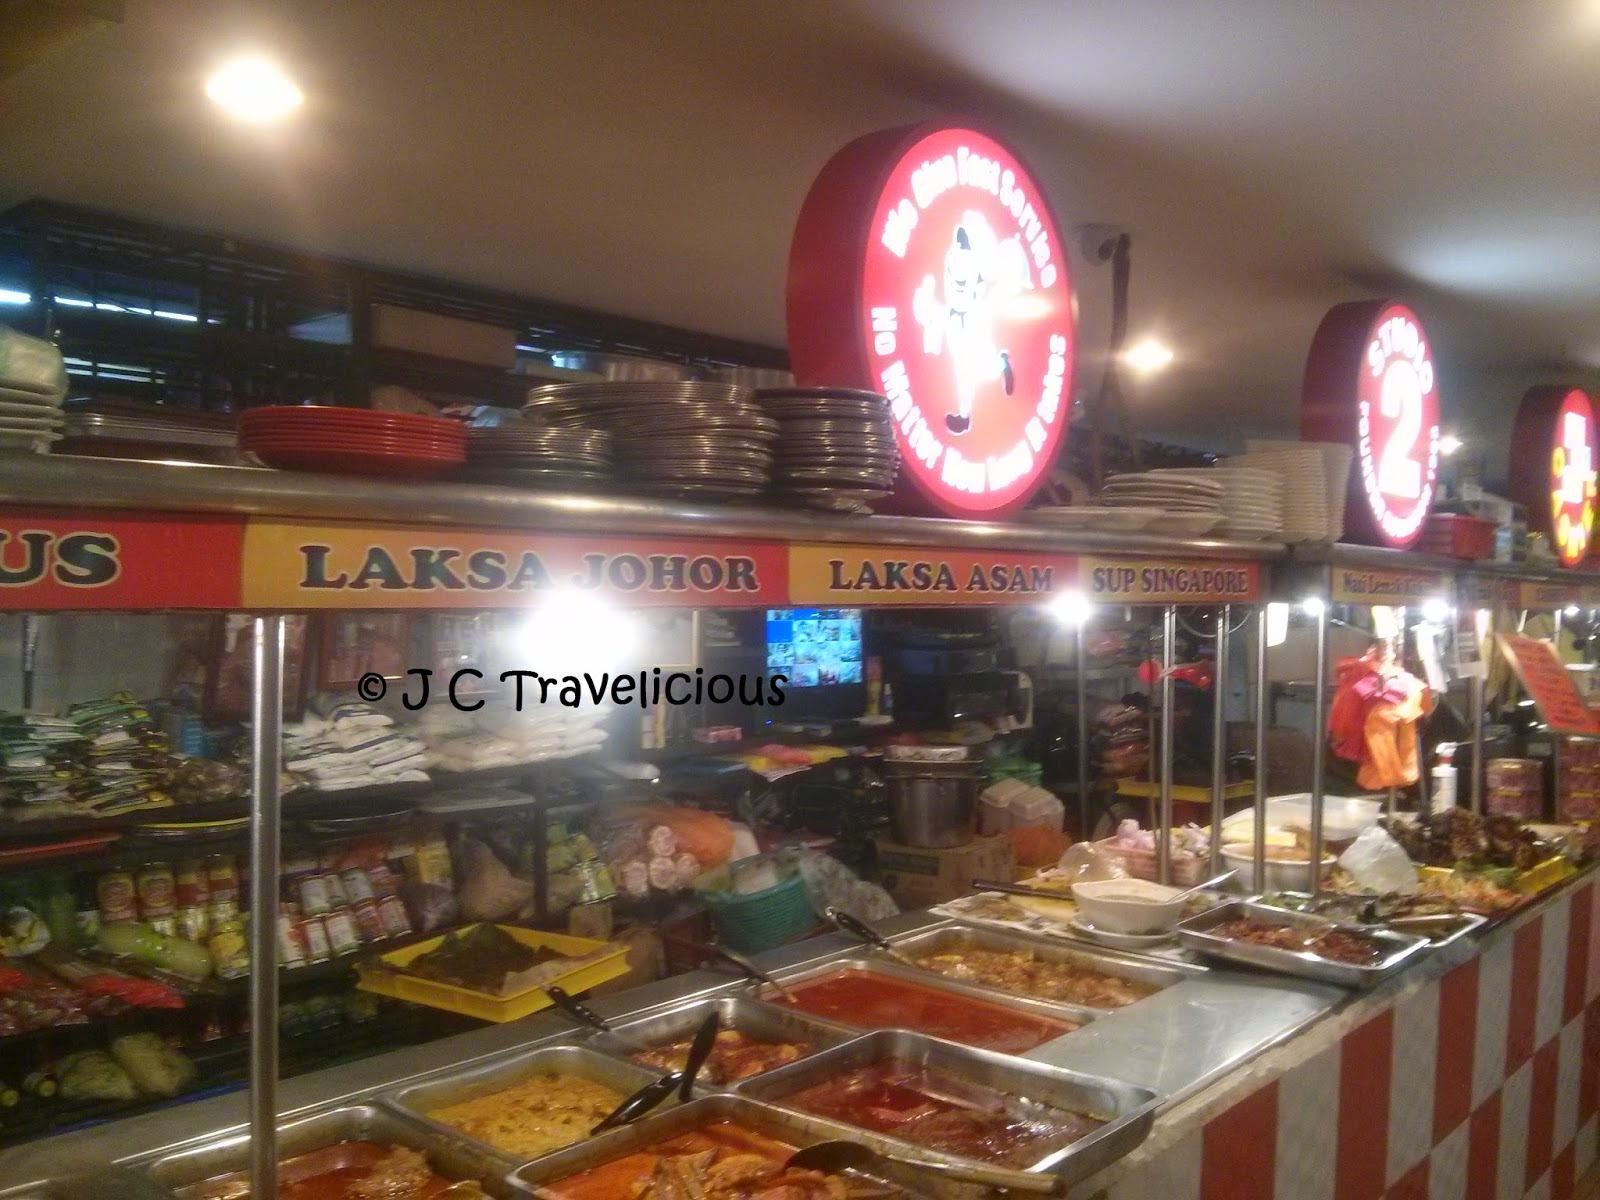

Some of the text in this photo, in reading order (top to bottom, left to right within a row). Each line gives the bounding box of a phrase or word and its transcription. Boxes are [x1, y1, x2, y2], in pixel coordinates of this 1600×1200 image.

[1000, 169, 1057, 288] Service
[1379, 359, 1422, 499] 2
[299, 544, 760, 593] LAKSA JOHOR
[829, 559, 1054, 593] LAKSA ASAM
[1093, 567, 1249, 594] SUP SINGAPORE
